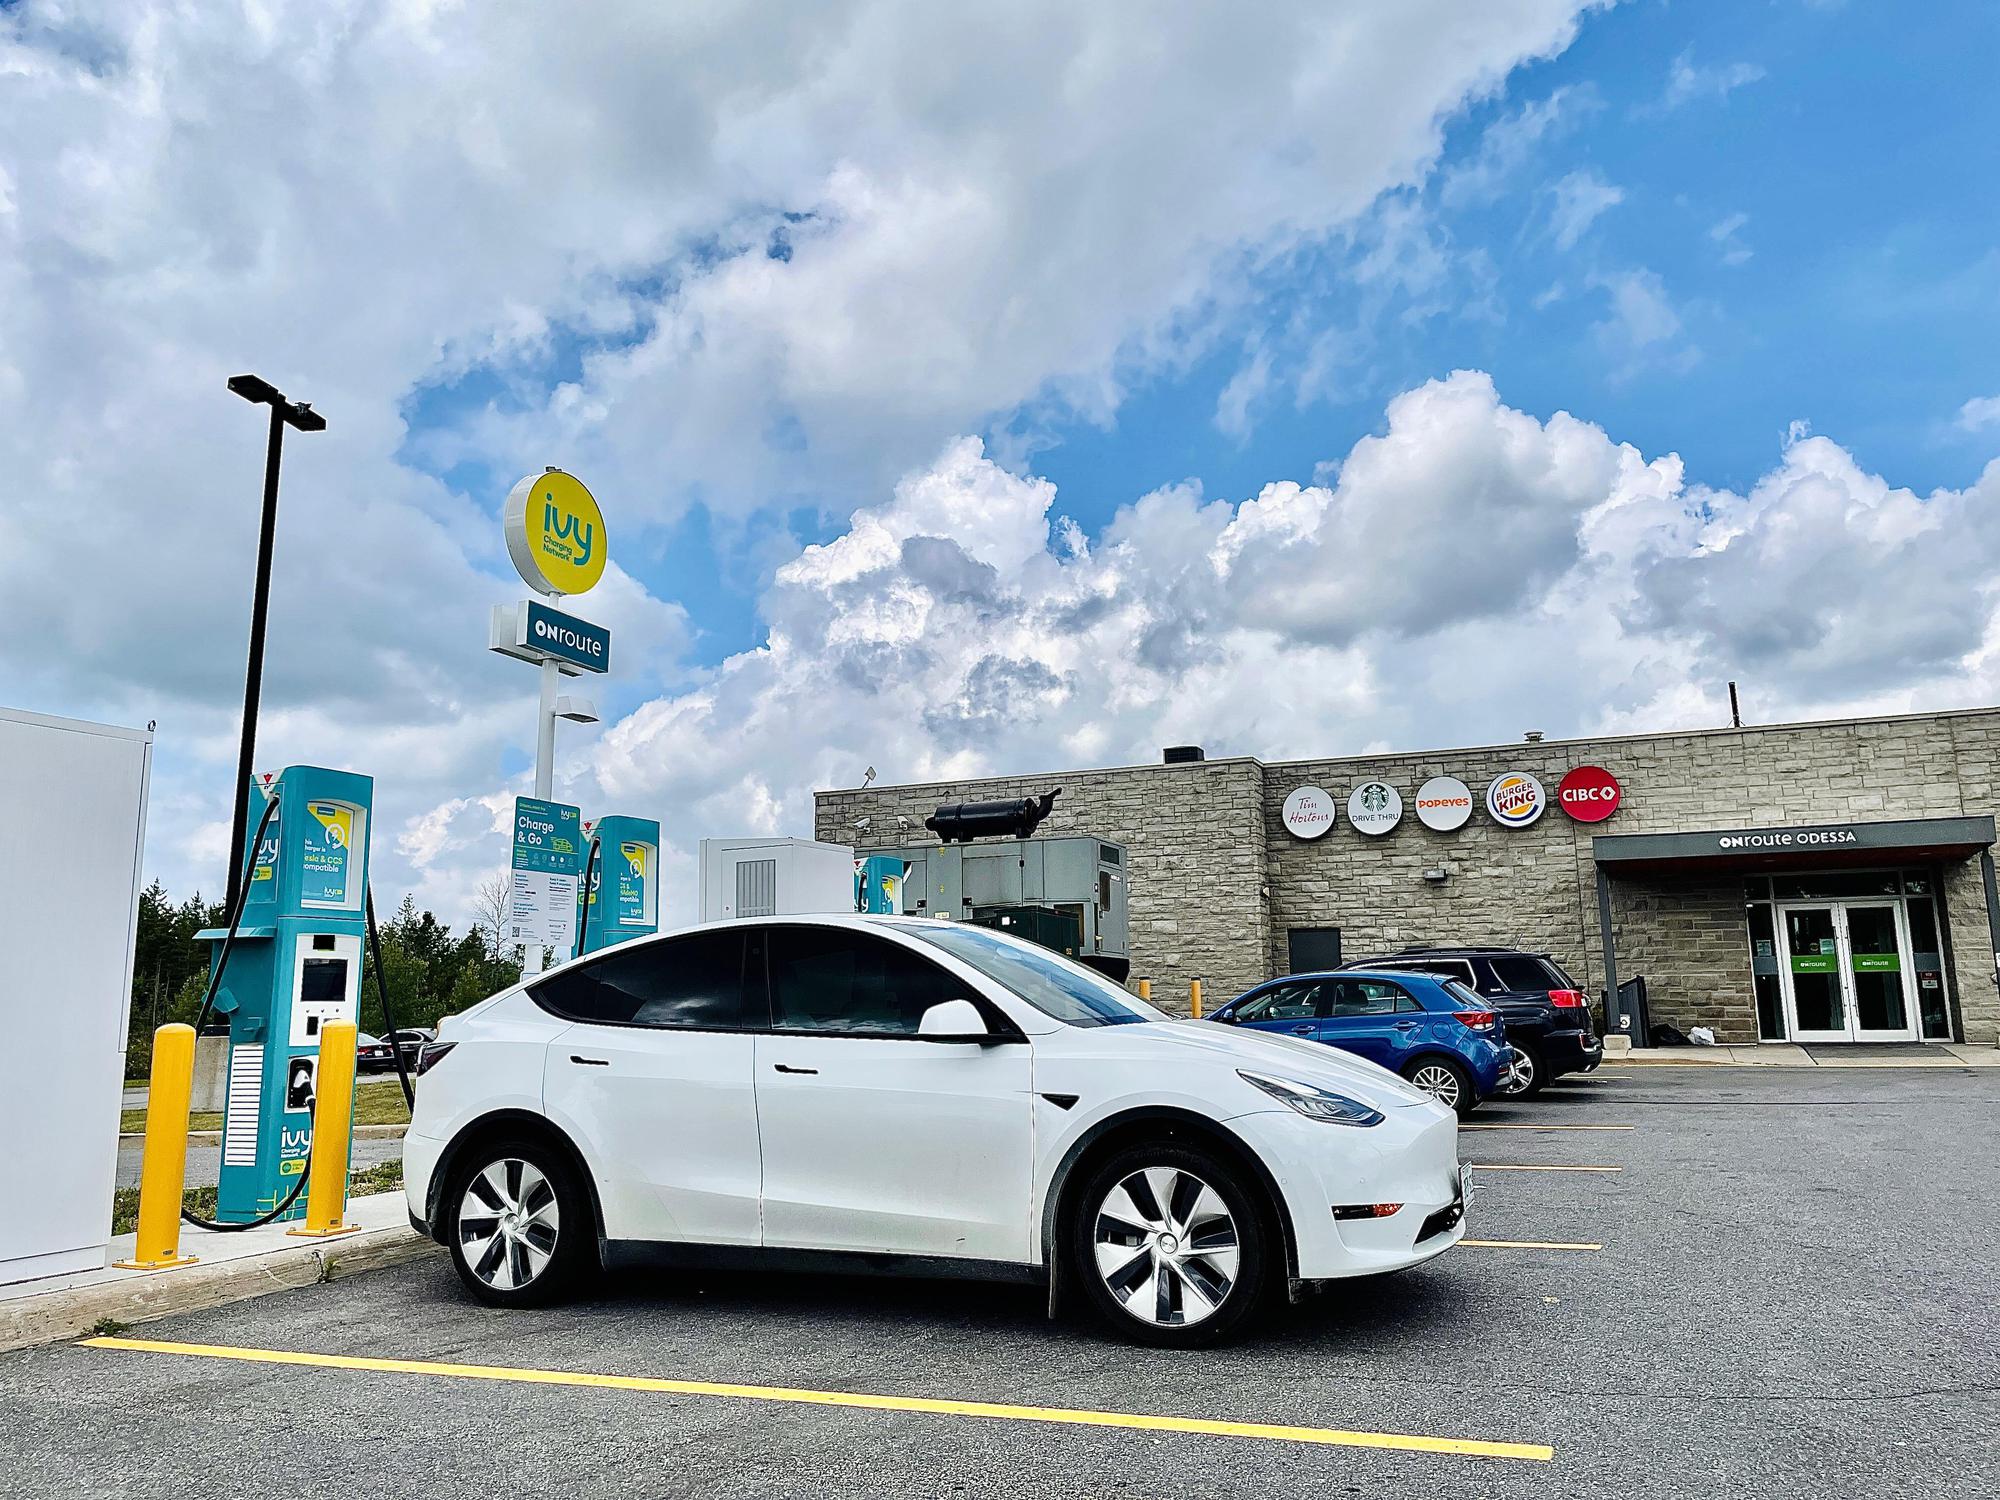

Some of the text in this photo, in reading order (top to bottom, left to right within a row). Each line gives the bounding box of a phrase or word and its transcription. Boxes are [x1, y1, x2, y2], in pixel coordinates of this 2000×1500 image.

[544, 493, 592, 566] ivy
[543, 535, 573, 556] Charging
[543, 543, 571, 562] Network
[535, 619, 602, 657] ONroute
[1496, 782, 1534, 801] BURGER
[1562, 787, 1599, 802] CIBC
[1298, 797, 1318, 810] Tim
[1499, 790, 1536, 813] KING
[518, 816, 554, 835] Charge
[1289, 811, 1329, 824] Hortons
[1352, 813, 1399, 823] DRIVE THRU
[517, 831, 542, 845] & Go
[1719, 831, 1857, 849] ONroute ODESSA
[304, 854, 319, 862] esla
[327, 856, 343, 865] CCS
[281, 1126, 312, 1157] ivy
